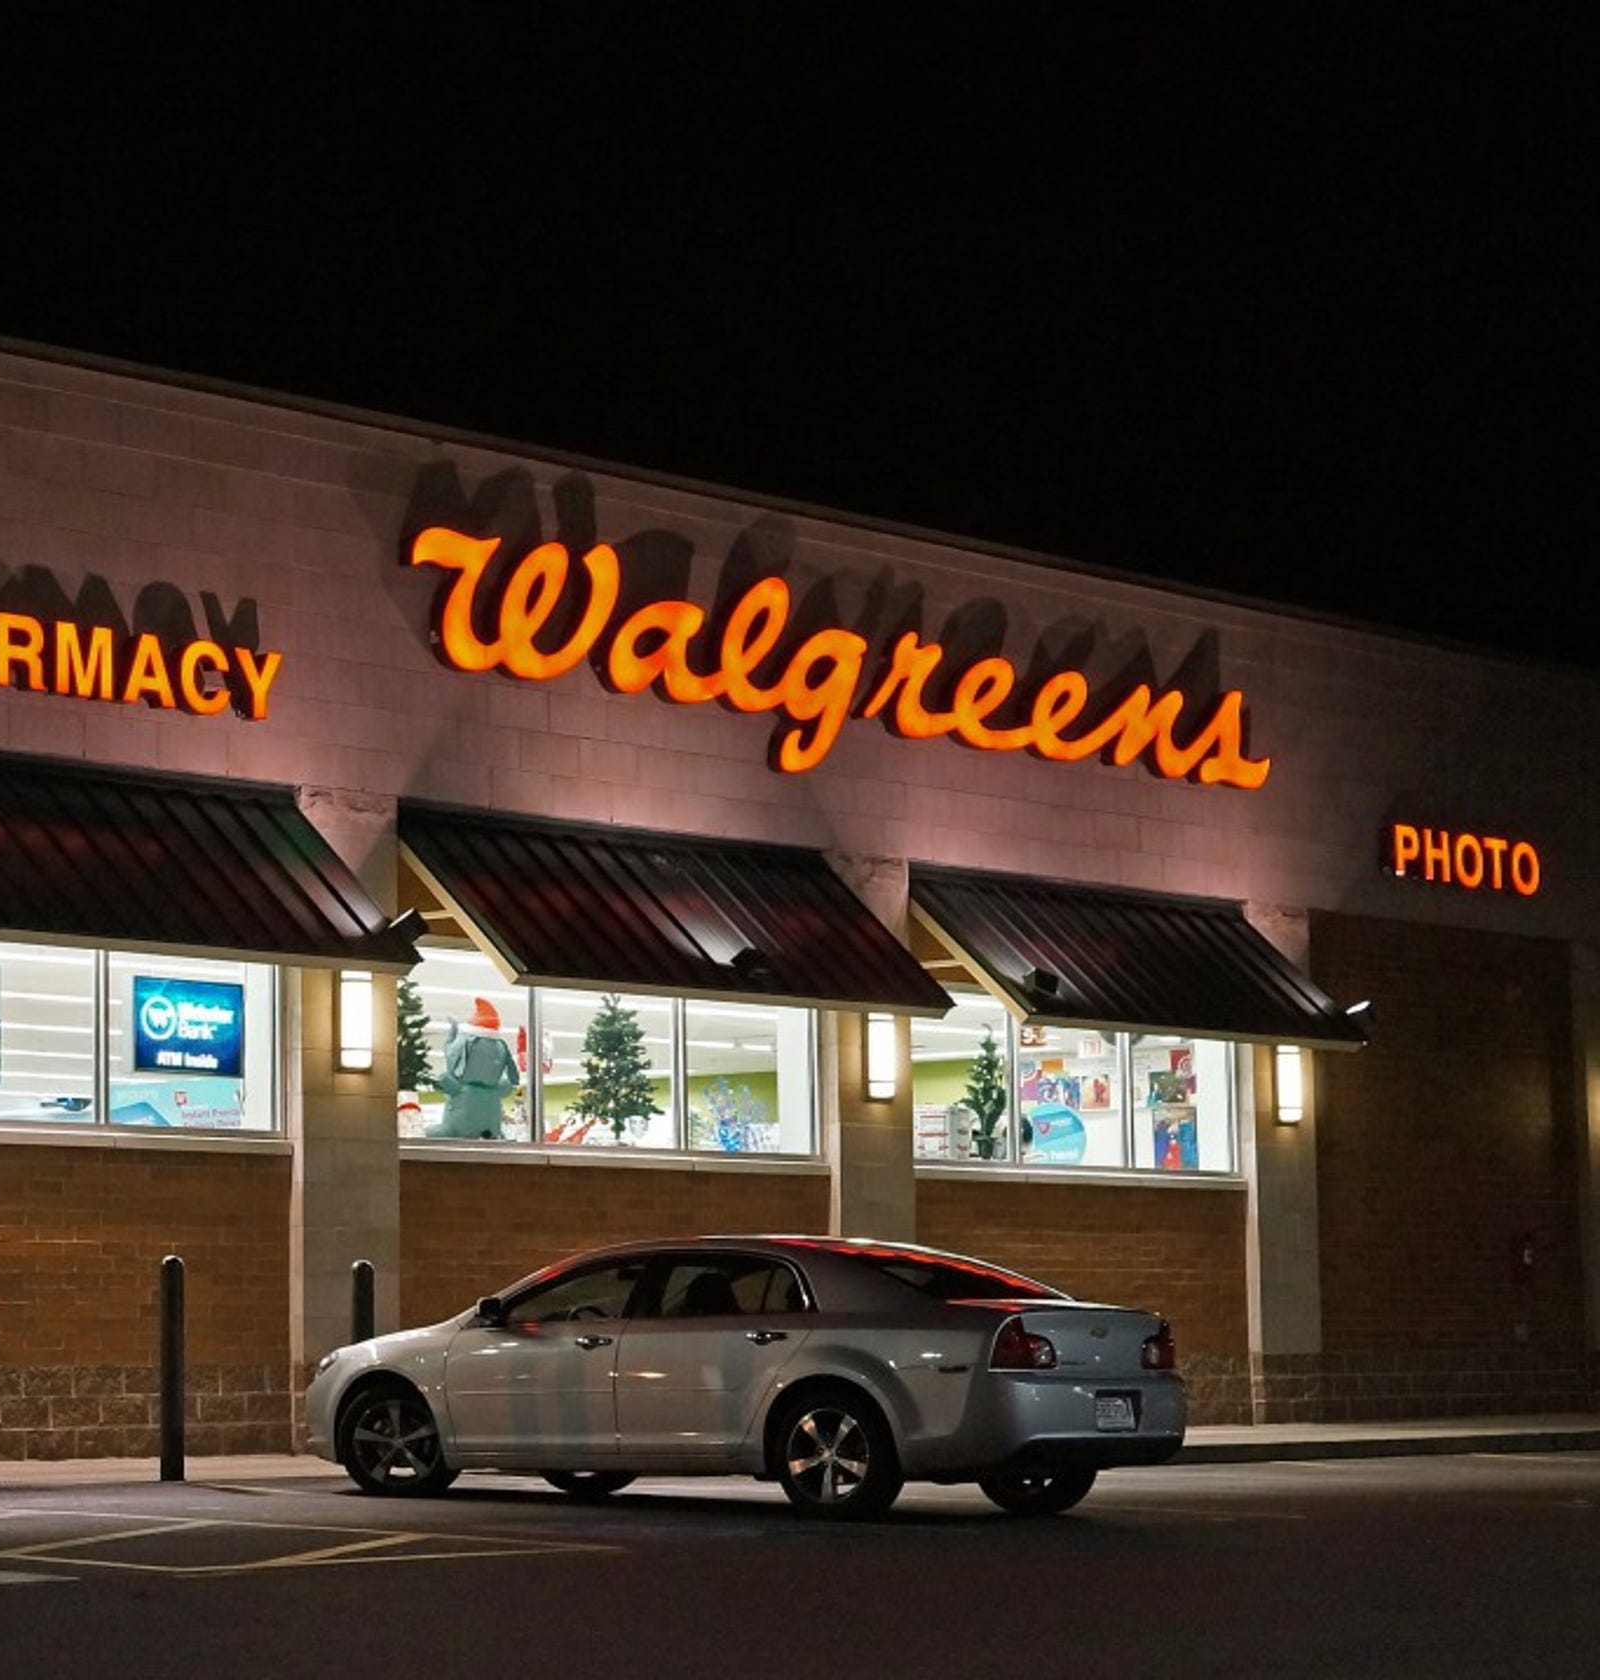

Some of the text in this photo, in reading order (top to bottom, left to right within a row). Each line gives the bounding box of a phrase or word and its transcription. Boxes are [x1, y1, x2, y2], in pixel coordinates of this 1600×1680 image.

[411, 526, 1272, 789] Walgreens
[1394, 823, 1541, 896] PHOTO
[157, 1051, 183, 1066] ATM
